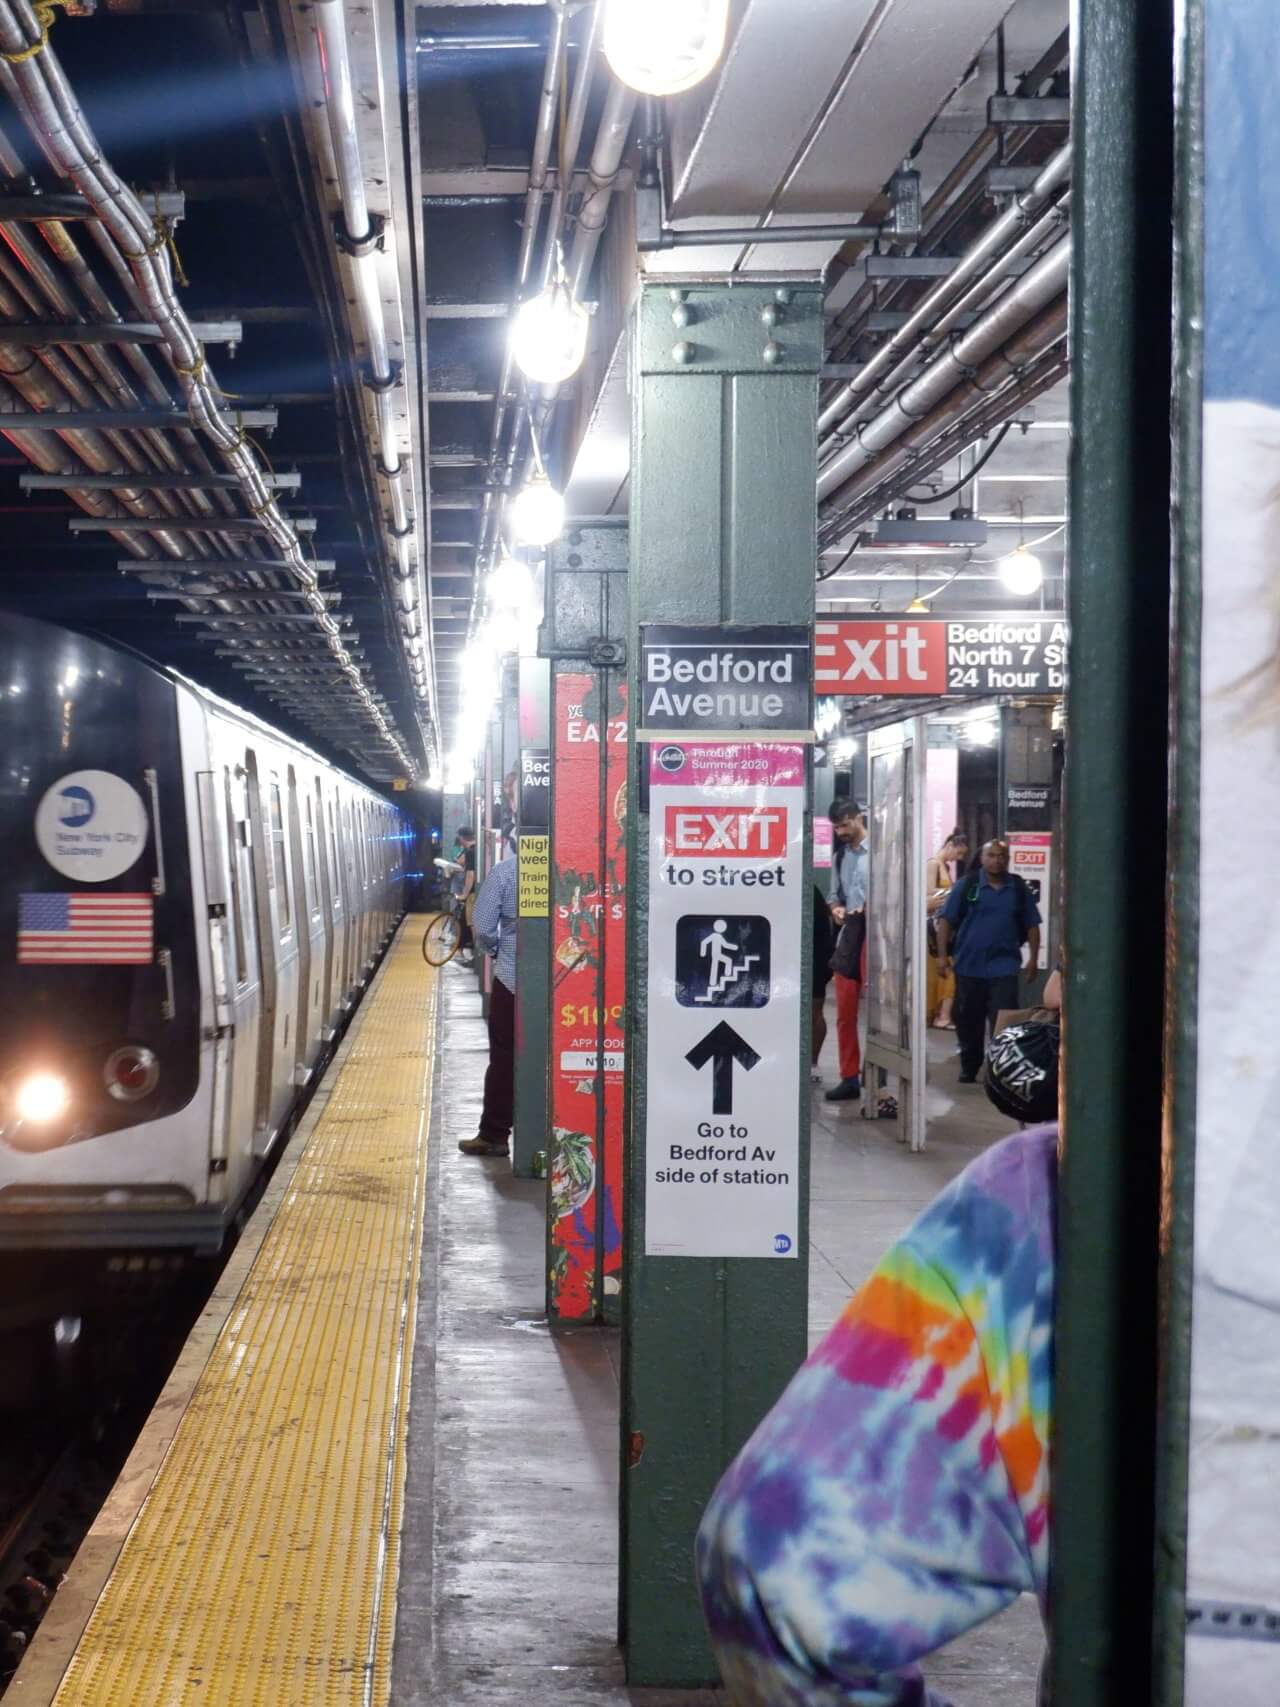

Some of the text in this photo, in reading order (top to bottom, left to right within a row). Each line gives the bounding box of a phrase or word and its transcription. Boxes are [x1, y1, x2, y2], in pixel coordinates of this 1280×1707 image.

[947, 623, 1041, 644] Bedford
[814, 623, 928, 681] Exit
[947, 645, 1013, 666] North
[1019, 647, 1037, 666] 7
[647, 653, 793, 683] Bedford
[948, 668, 980, 688] 24
[987, 667, 1040, 688] hour
[647, 687, 784, 717] Avenue
[691, 760, 769, 770] Summer 2020
[675, 813, 780, 850] EXIT
[666, 865, 786, 887] to street
[697, 1122, 748, 1138] Go to
[670, 1144, 776, 1161] Bedford Av
[655, 1168, 789, 1184] side of station
